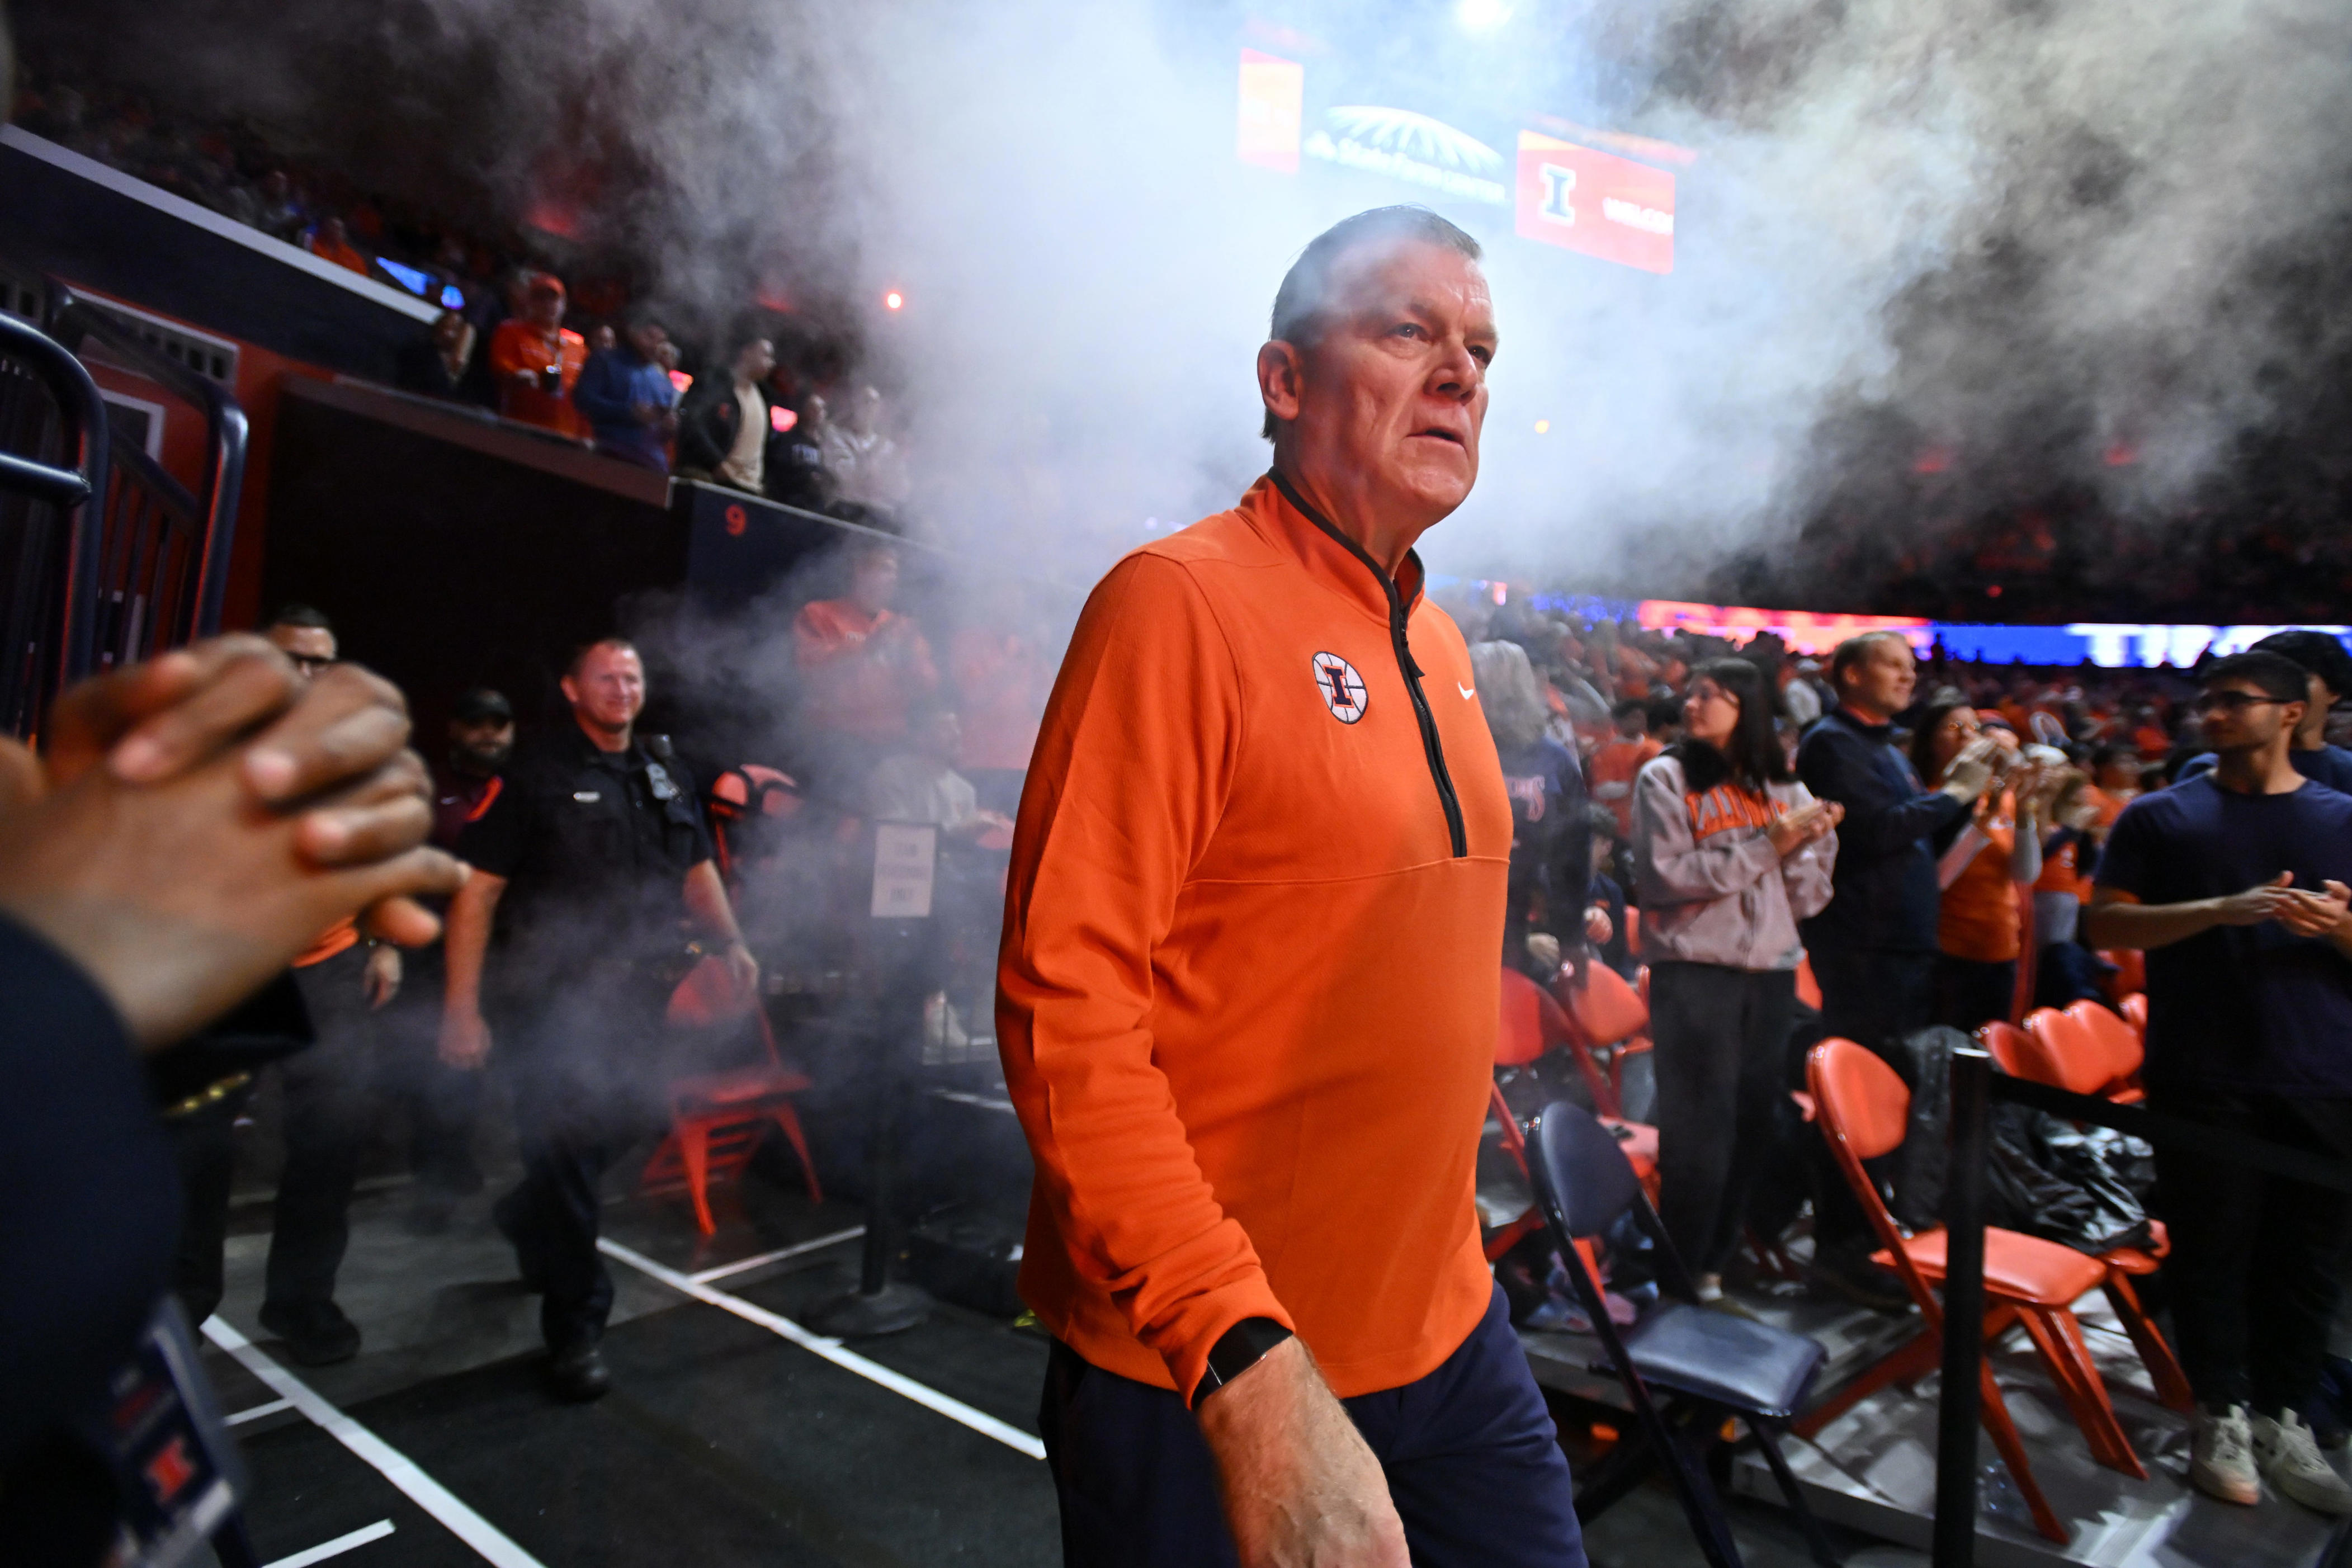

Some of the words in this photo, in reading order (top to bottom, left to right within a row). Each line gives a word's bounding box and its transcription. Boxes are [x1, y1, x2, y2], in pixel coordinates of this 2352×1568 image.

[1540, 163, 1575, 225] I
[726, 504, 745, 535] 9
[1323, 664, 1354, 707] I
